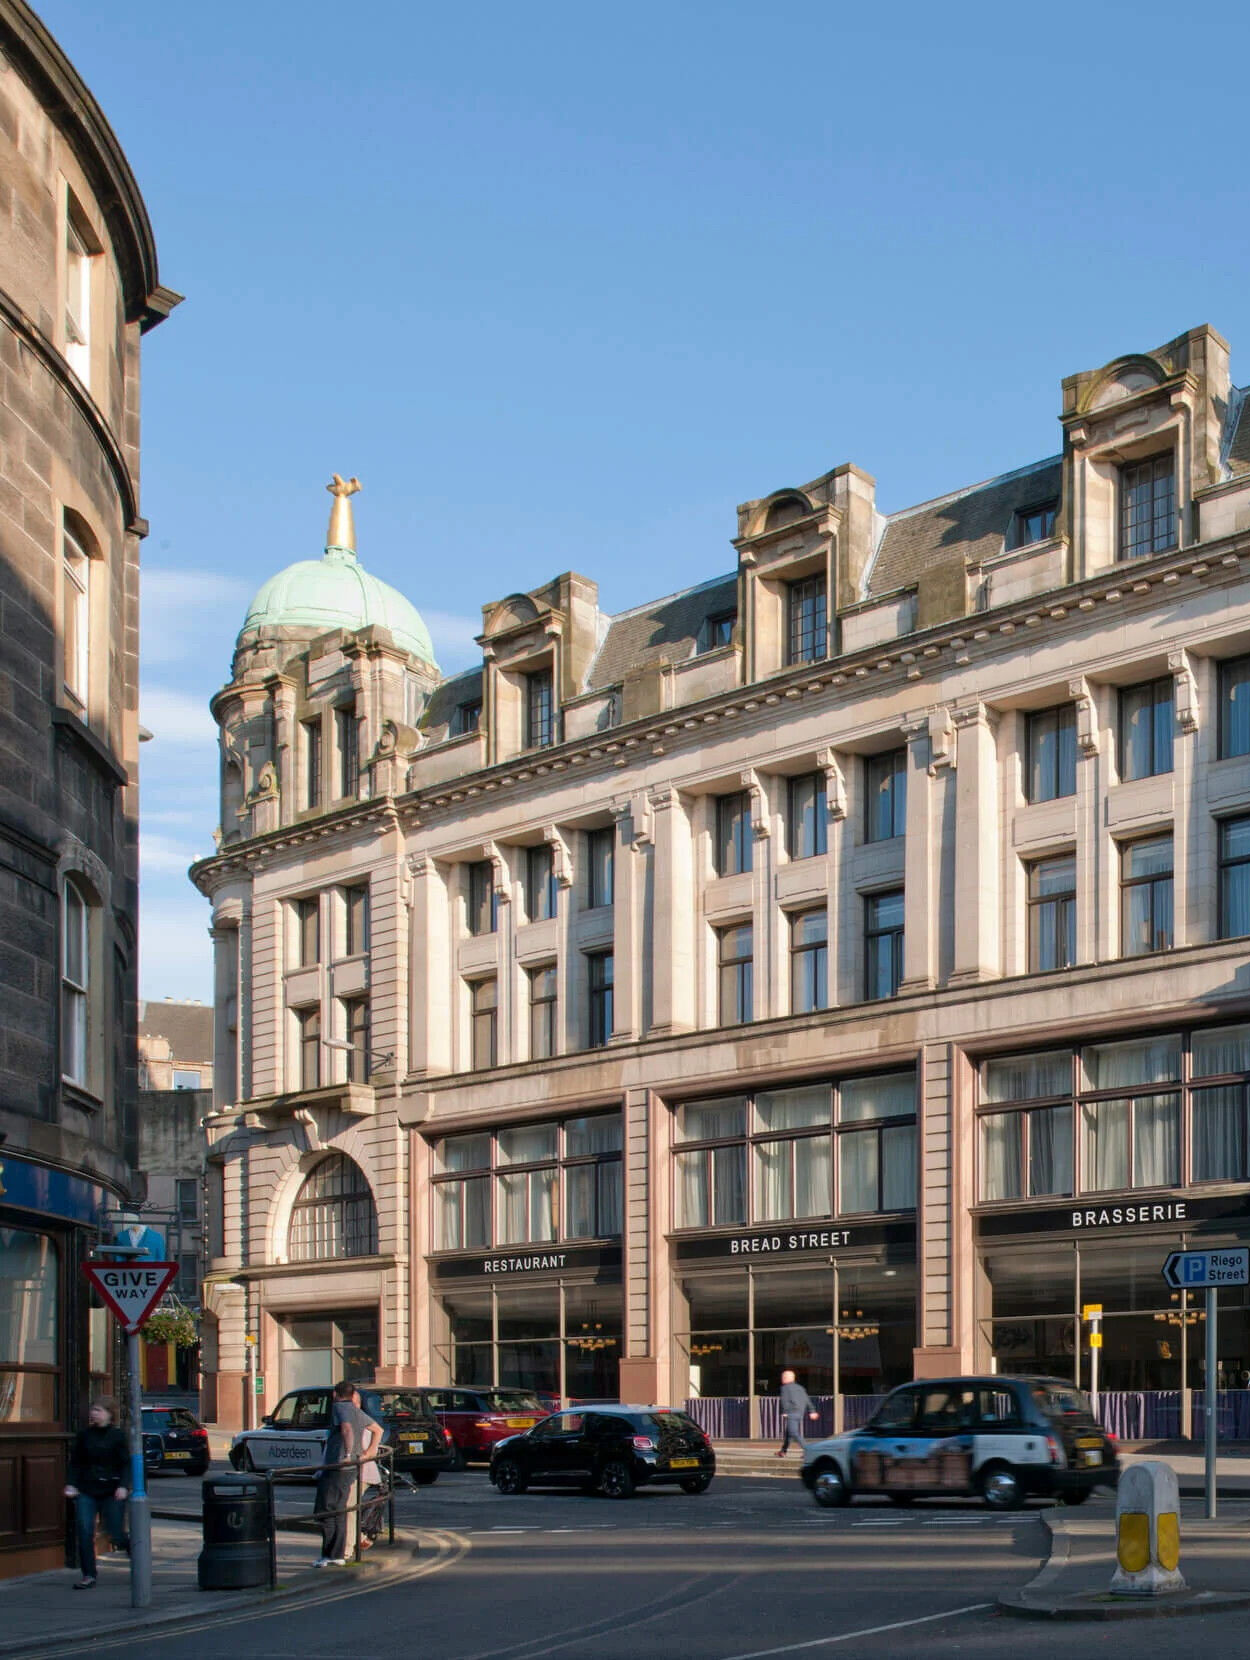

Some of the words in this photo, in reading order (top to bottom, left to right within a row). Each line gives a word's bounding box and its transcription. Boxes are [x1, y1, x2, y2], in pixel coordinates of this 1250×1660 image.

[1072, 1203, 1186, 1227] BRASSERIE
[730, 1236, 781, 1254] BREAD
[789, 1231, 850, 1249] STREET
[484, 1254, 566, 1273] RESTAURANT
[1211, 1255, 1243, 1268] Riego
[103, 1272, 158, 1287] GIVE
[1208, 1268, 1246, 1281] Street
[115, 1289, 149, 1299] WAY
[269, 1444, 312, 1459] Aberdeen
